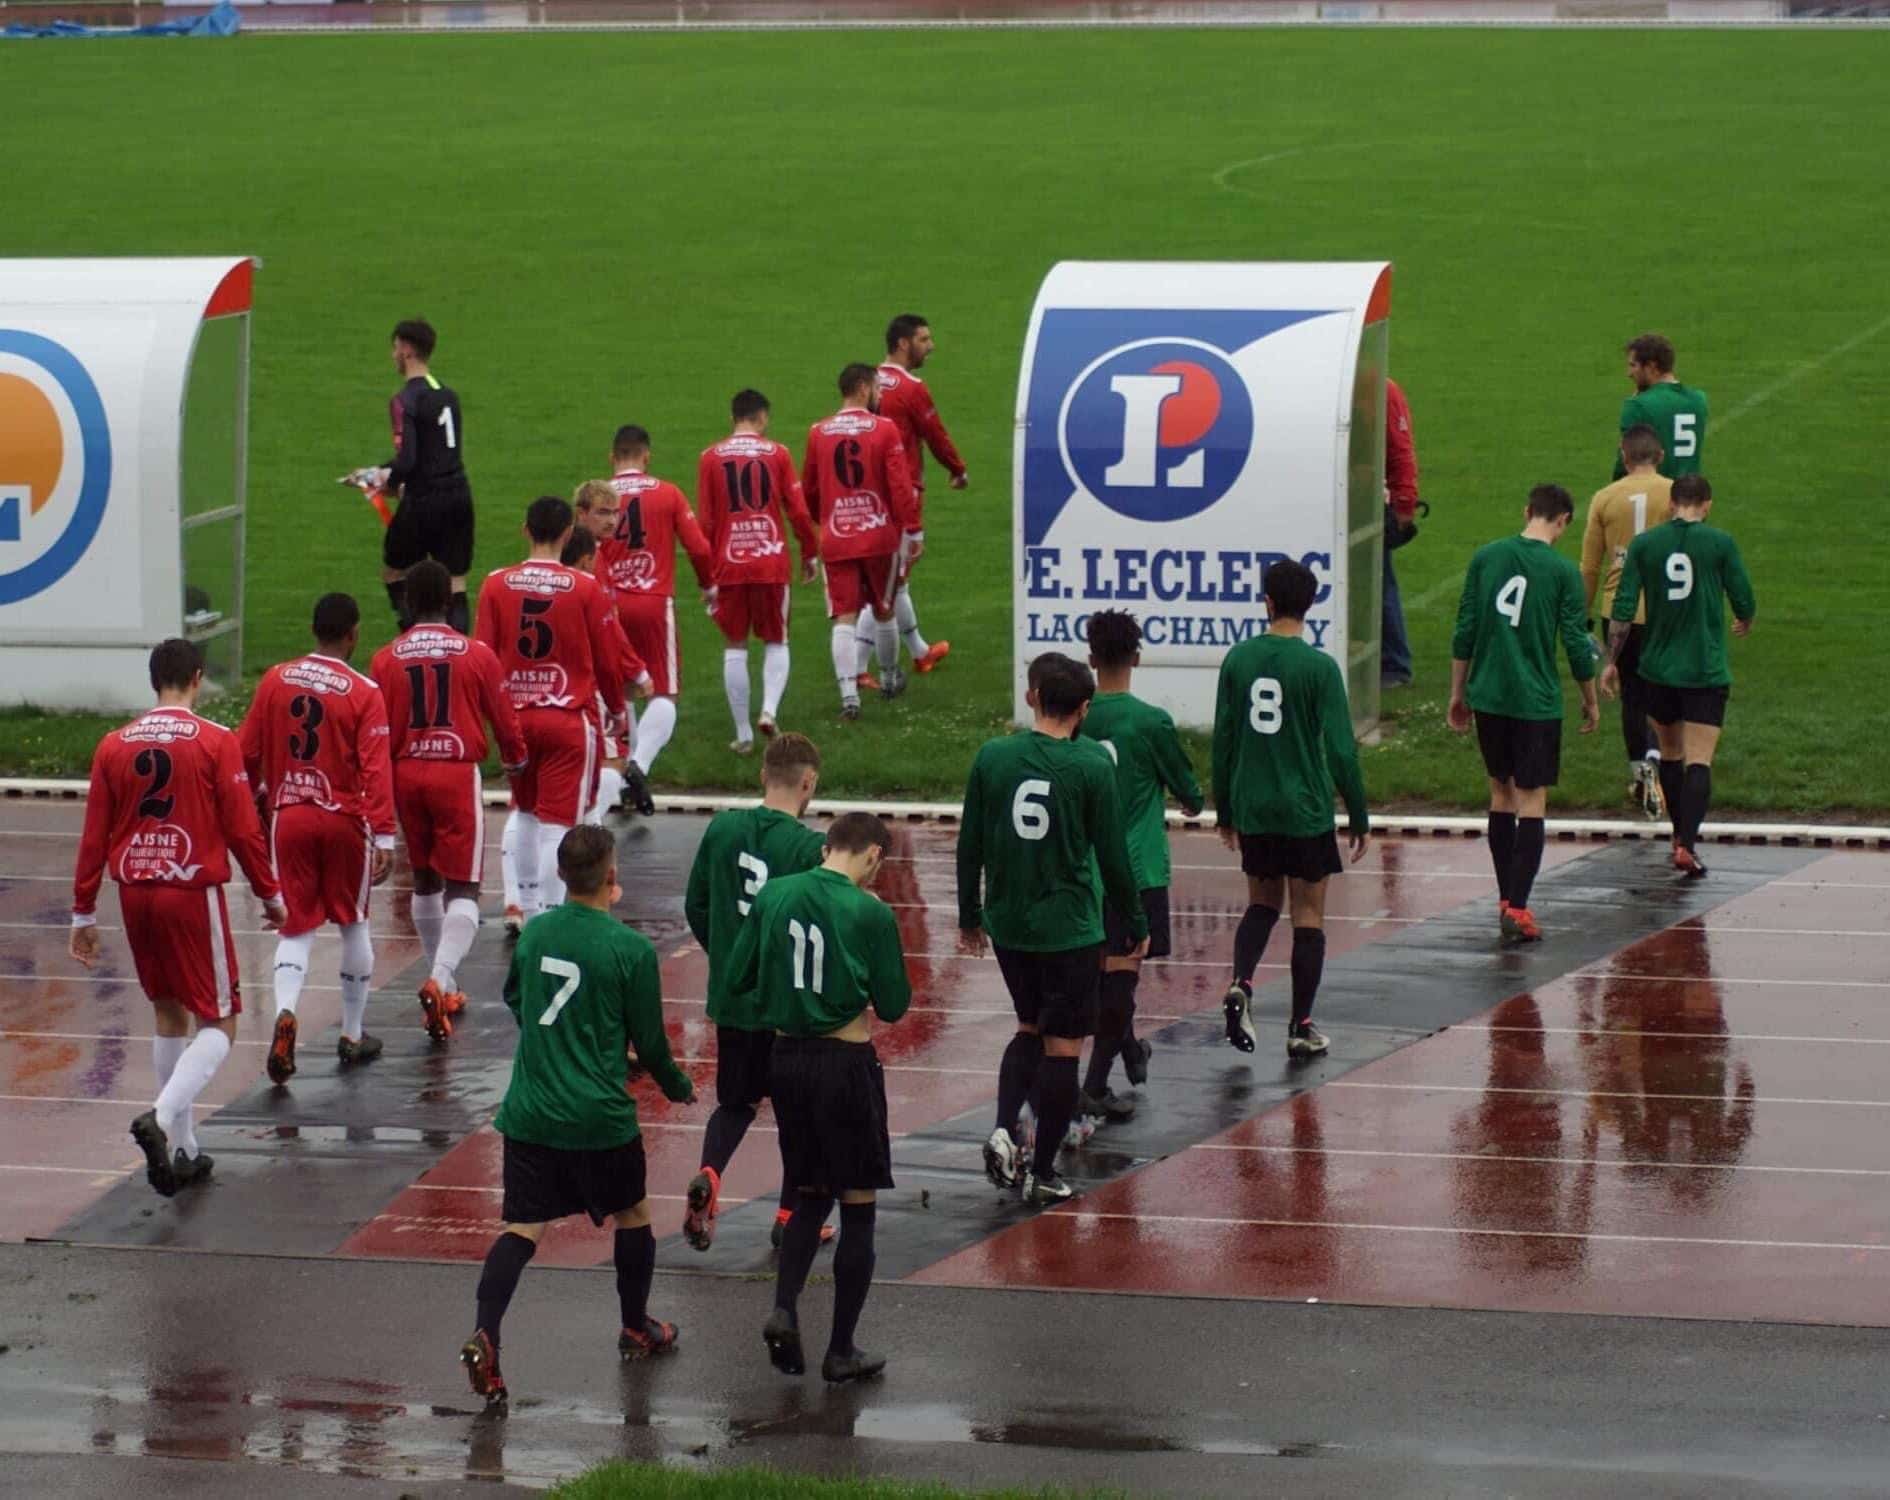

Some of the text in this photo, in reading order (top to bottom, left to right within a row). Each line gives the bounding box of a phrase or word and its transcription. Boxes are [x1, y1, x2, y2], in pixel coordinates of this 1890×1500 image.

[438, 406, 457, 448] 1
[1104, 374, 1205, 488] L
[1673, 413, 1697, 457] 5
[722, 459, 773, 514] 10
[833, 438, 866, 489] 6
[615, 497, 647, 550] 4
[1628, 493, 1648, 535] 1
[508, 574, 571, 588] campana
[1495, 574, 1528, 628] 4
[1665, 552, 1694, 602] 9
[397, 638, 463, 653] campana
[516, 597, 555, 660] 5
[1027, 613, 1331, 648] LA CHAMY
[284, 667, 348, 690] campana
[404, 662, 453, 730] 11
[511, 670, 558, 683] AISNE
[288, 693, 324, 762] 3
[1249, 677, 1283, 735] 8
[134, 748, 175, 820] 2
[285, 770, 322, 788] ASNE
[1012, 779, 1051, 840] 6
[131, 833, 179, 847] AISNE
[737, 851, 769, 917] 3
[788, 918, 824, 995] 11
[537, 956, 581, 1026] 7
